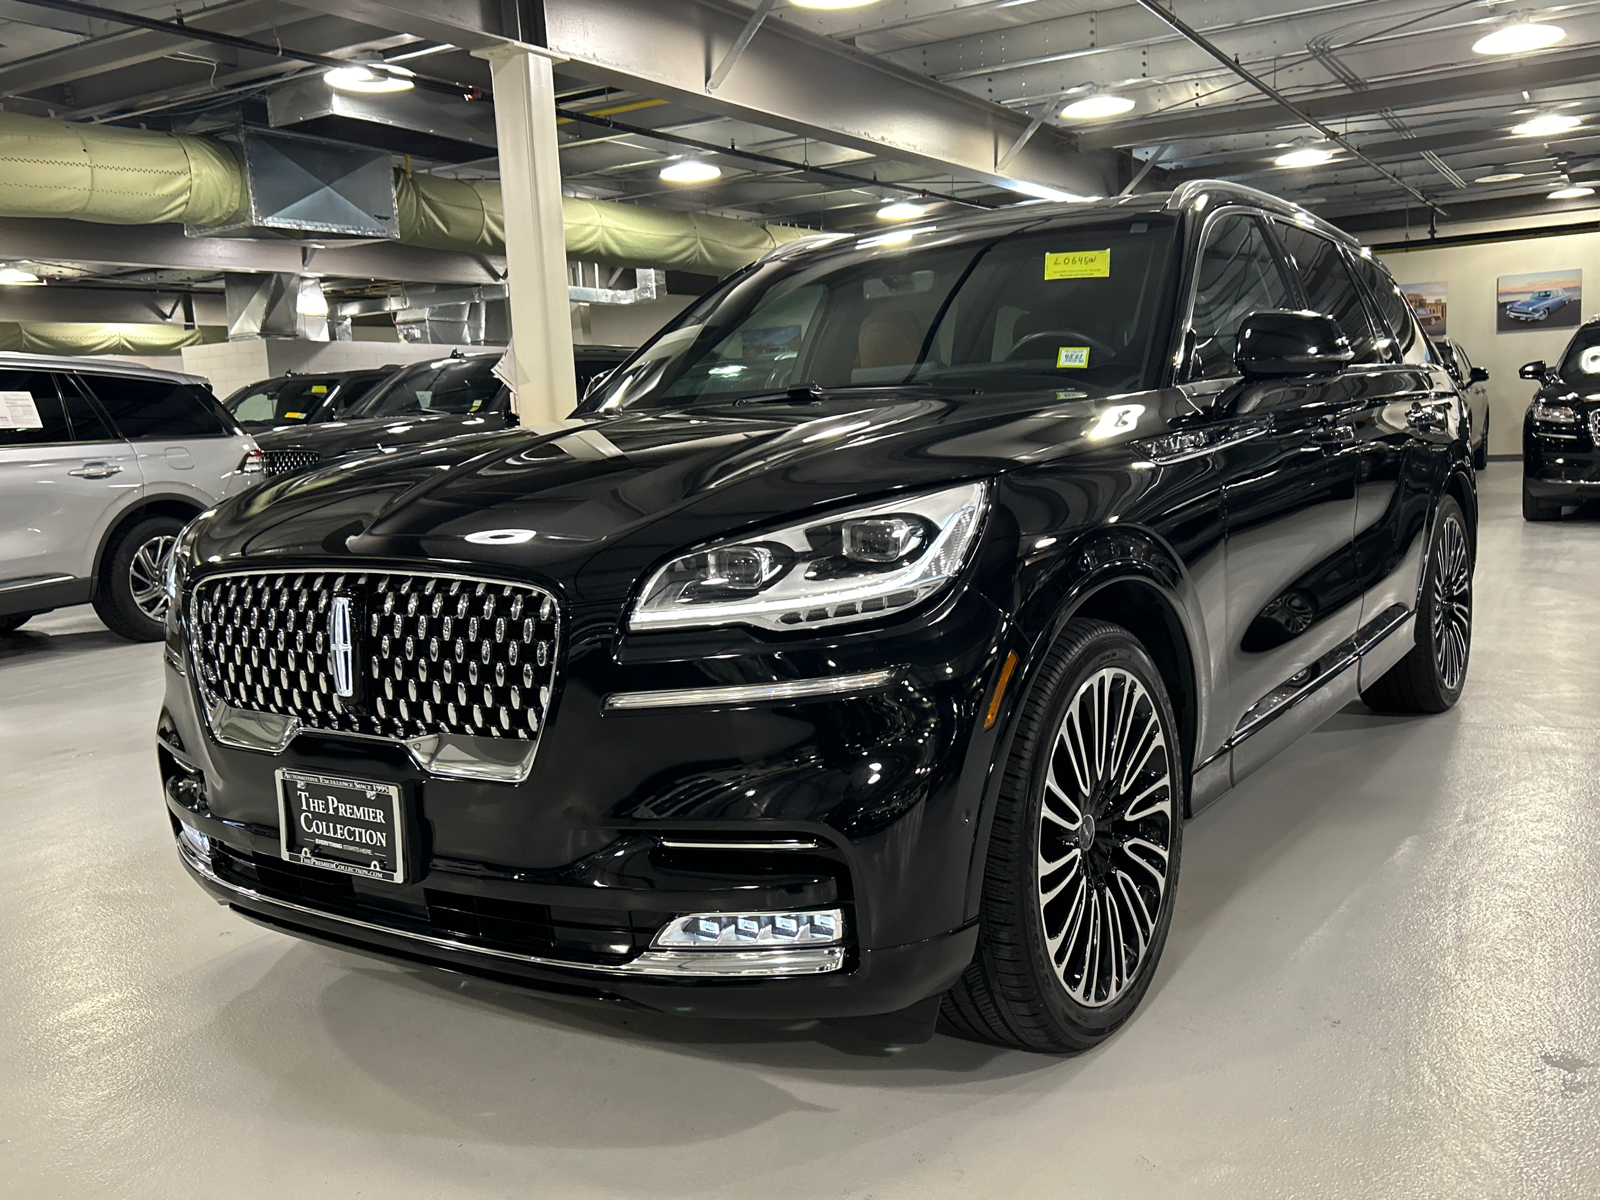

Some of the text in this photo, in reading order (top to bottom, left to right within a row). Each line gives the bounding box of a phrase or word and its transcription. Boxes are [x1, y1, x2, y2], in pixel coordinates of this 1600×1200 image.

[354, 781, 373, 791] SINCE
[373, 785, 390, 794] 1995
[297, 790, 386, 824] THE PREMIER
[300, 812, 387, 848] COLLECTION
[315, 838, 343, 850] EVERYTHING
